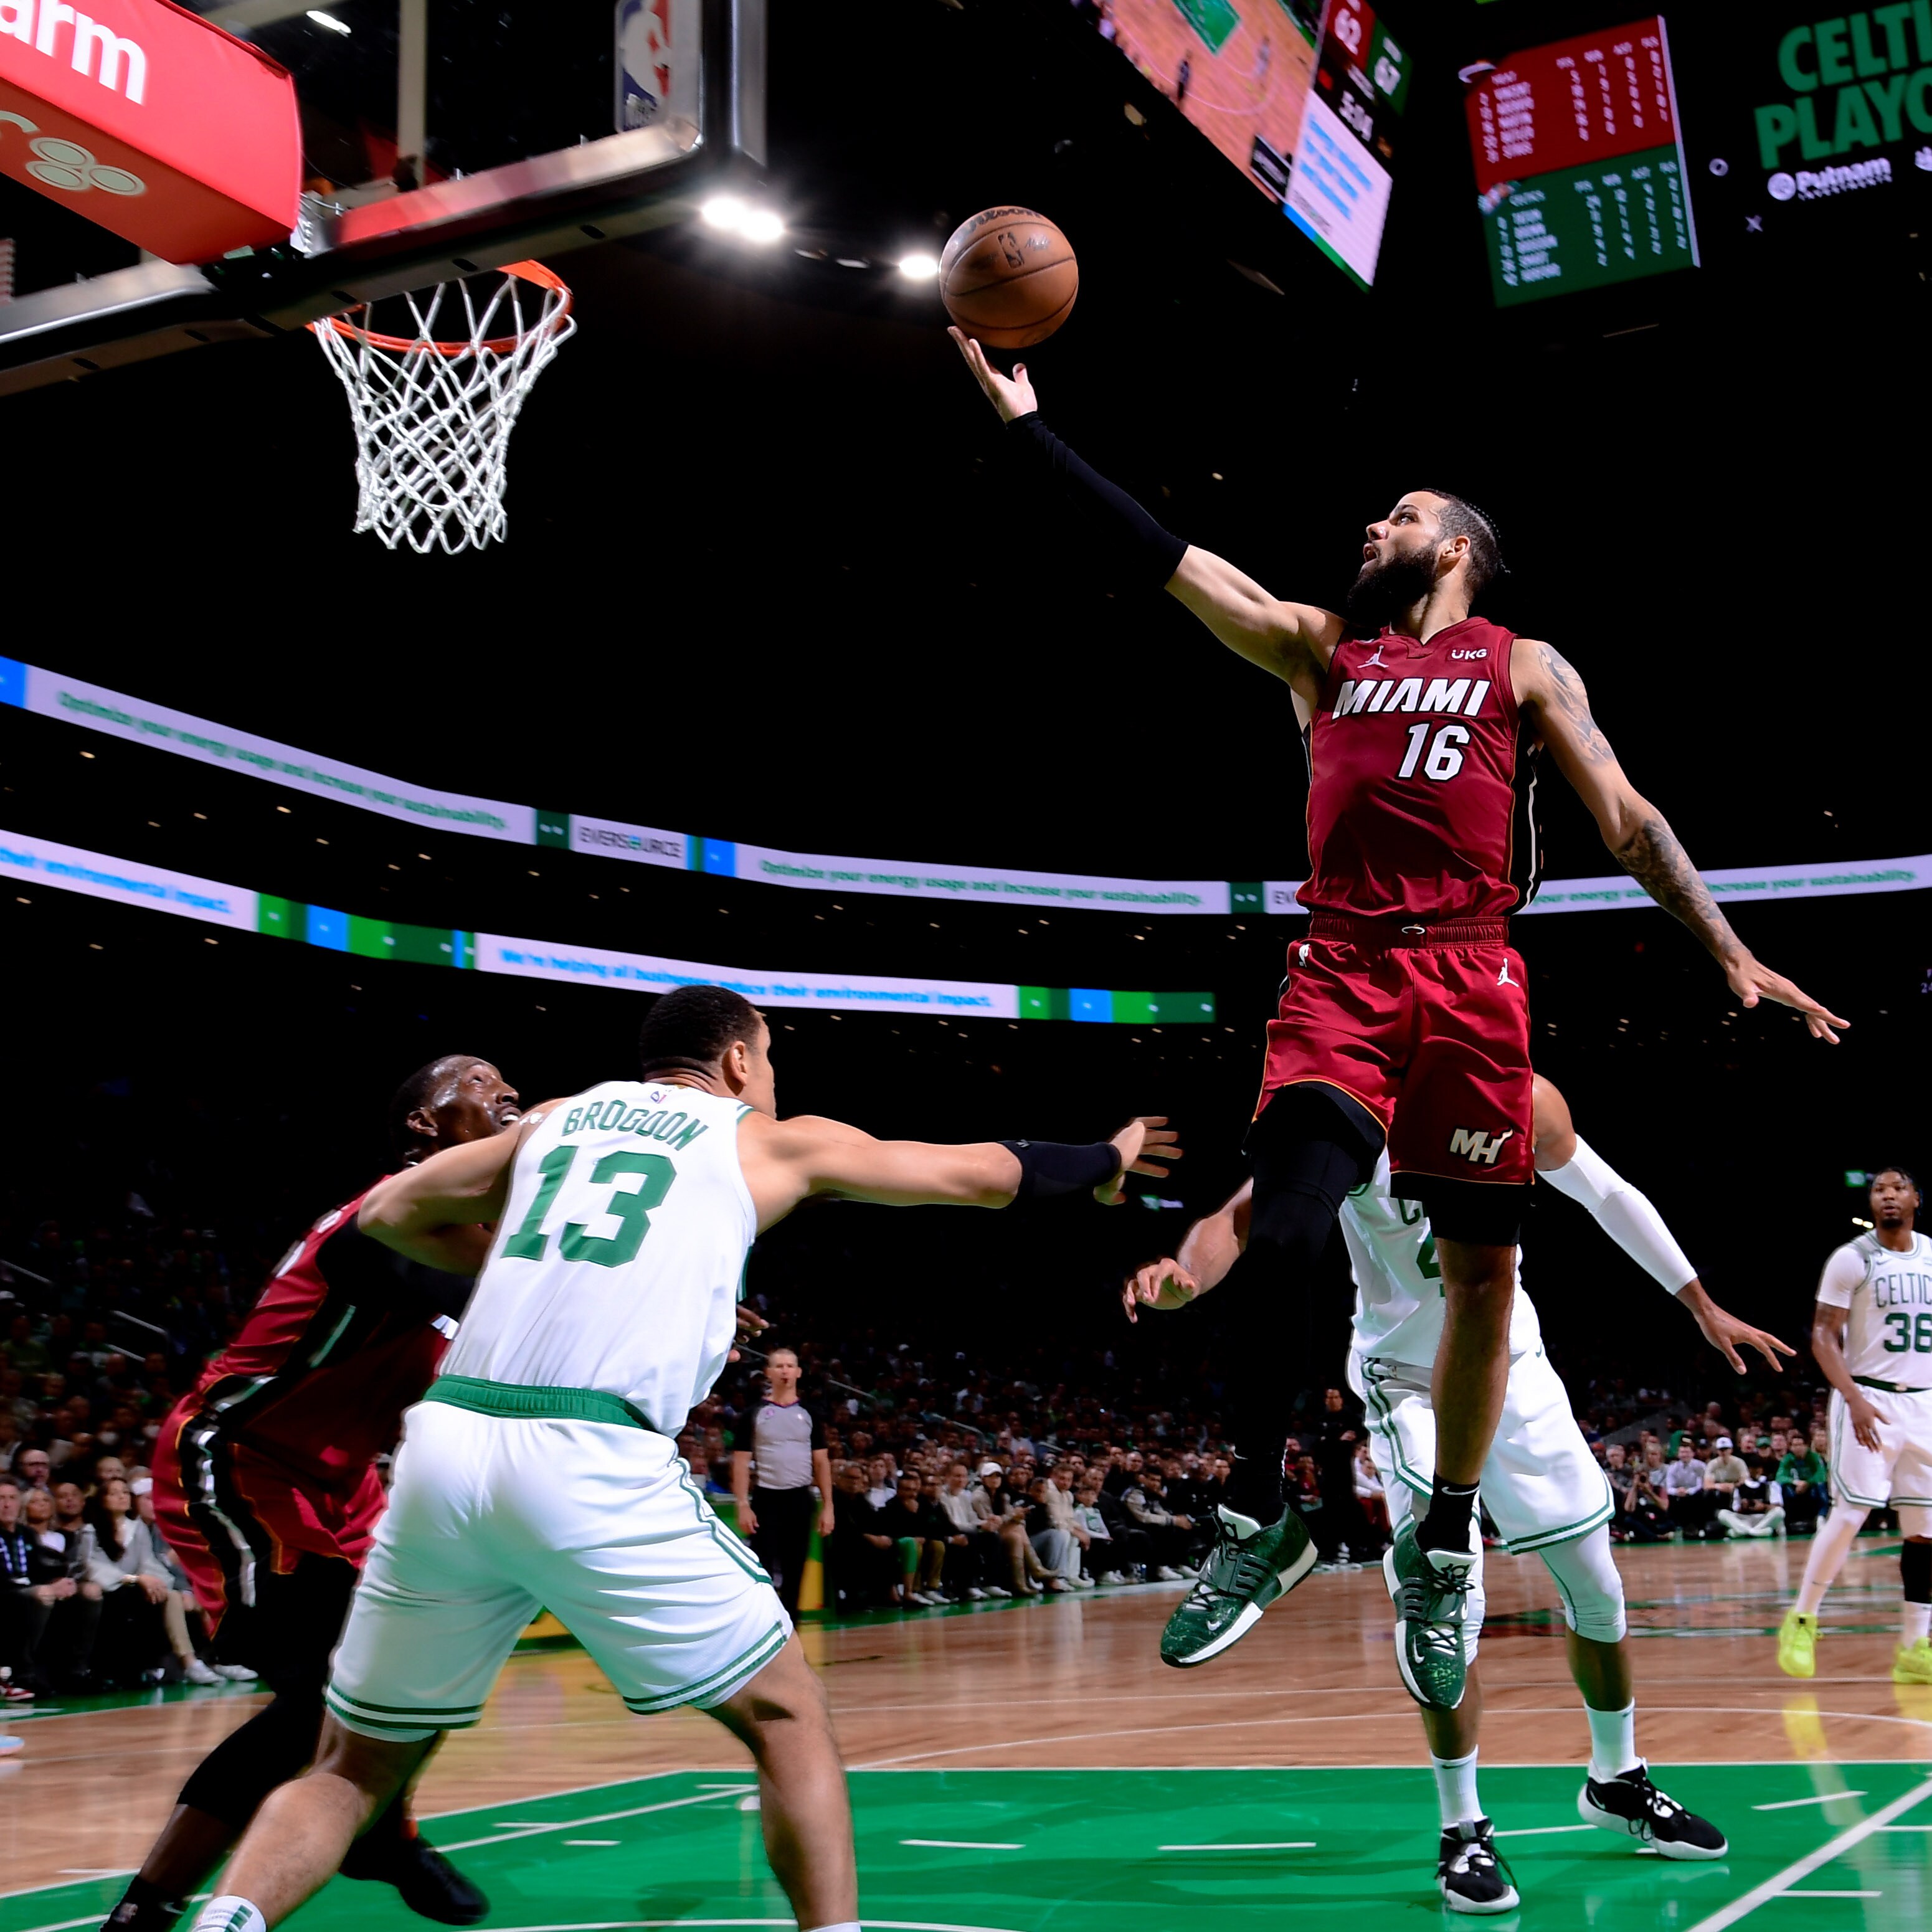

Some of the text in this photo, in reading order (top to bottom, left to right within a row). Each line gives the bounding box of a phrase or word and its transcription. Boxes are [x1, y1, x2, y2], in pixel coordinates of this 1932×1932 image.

[1332, 678, 1492, 721] MIAMI
[1398, 722, 1471, 782] 16
[579, 826, 683, 859] EVERSOURCE
[562, 1100, 709, 1152] BROGDON
[500, 1144, 677, 1269] 13
